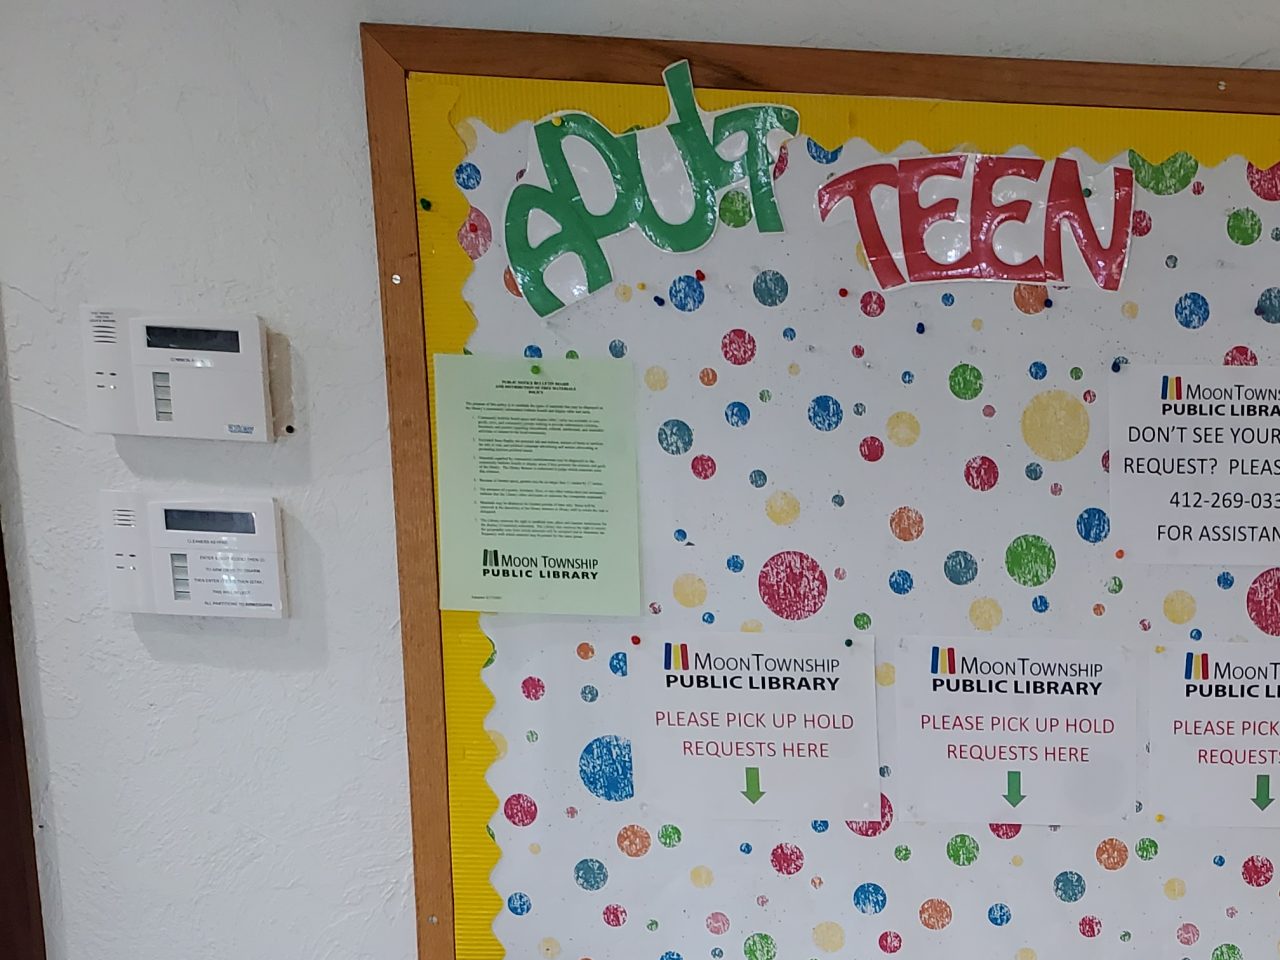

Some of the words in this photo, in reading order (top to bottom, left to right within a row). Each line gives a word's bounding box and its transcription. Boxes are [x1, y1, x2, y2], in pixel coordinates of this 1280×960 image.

[818, 154, 1134, 291] TEEN
[1186, 384, 1233, 401] MOON
[1161, 403, 1225, 416] PUBLIC
[1128, 426, 1187, 443] DON'T
[1192, 427, 1224, 443] SEE
[1124, 457, 1217, 476] REQUEST?
[1157, 525, 1193, 541] FOR
[501, 554, 538, 568] MOON
[541, 556, 599, 570] TOWNSHIP
[482, 569, 533, 578] PUBLIC
[539, 570, 598, 580] LIBRARY
[694, 652, 750, 672] MOON
[751, 653, 840, 673] TOWNSHIP
[960, 656, 1016, 676] MOON
[1017, 658, 1103, 677] TOWNSHIP
[1213, 662, 1268, 680] MOON
[666, 674, 743, 689] PUBLIC
[748, 676, 840, 691] LIBRARY
[932, 678, 1008, 693] PUBLIC
[1013, 680, 1103, 695] LIBRARY
[1185, 684, 1259, 698] PUBLIC
[655, 711, 720, 727] PLEASE
[726, 712, 766, 728] PICK
[772, 713, 797, 729] UP
[803, 714, 854, 730] HOLD
[920, 714, 984, 731] PLEASE
[991, 716, 1030, 732] PICK
[1036, 717, 1059, 733] UP
[1066, 718, 1115, 734] HOLD
[1173, 720, 1235, 735] PLEASE
[1241, 720, 1279, 736] PICK
[682, 740, 776, 758] REQUESTS
[783, 742, 829, 758] HERE
[947, 744, 1038, 761] REQUESTS
[1044, 746, 1089, 762] HERE
